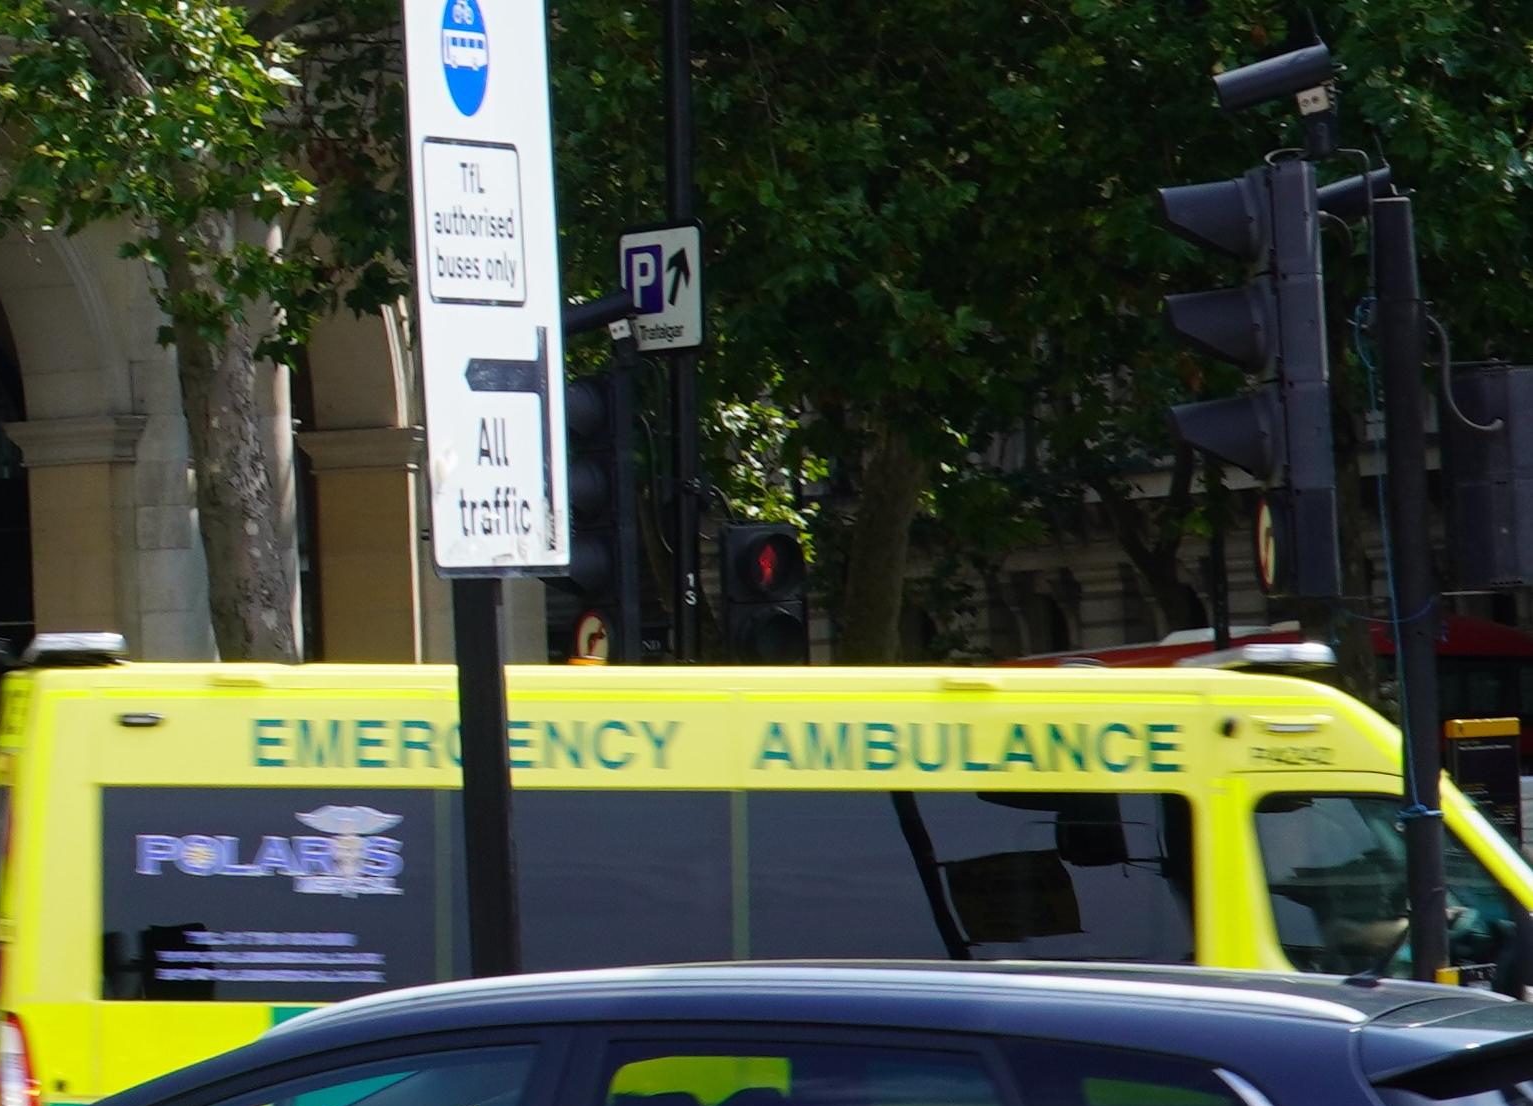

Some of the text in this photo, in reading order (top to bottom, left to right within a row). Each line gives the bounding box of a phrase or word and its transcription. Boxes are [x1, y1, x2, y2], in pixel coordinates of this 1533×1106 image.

[459, 161, 486, 194] TfL
[433, 205, 515, 239] authorised
[435, 247, 517, 288] buses only
[631, 252, 657, 309] P
[478, 417, 509, 467] All
[459, 486, 531, 537] traffic
[753, 722, 1187, 774] AMBULANCE
